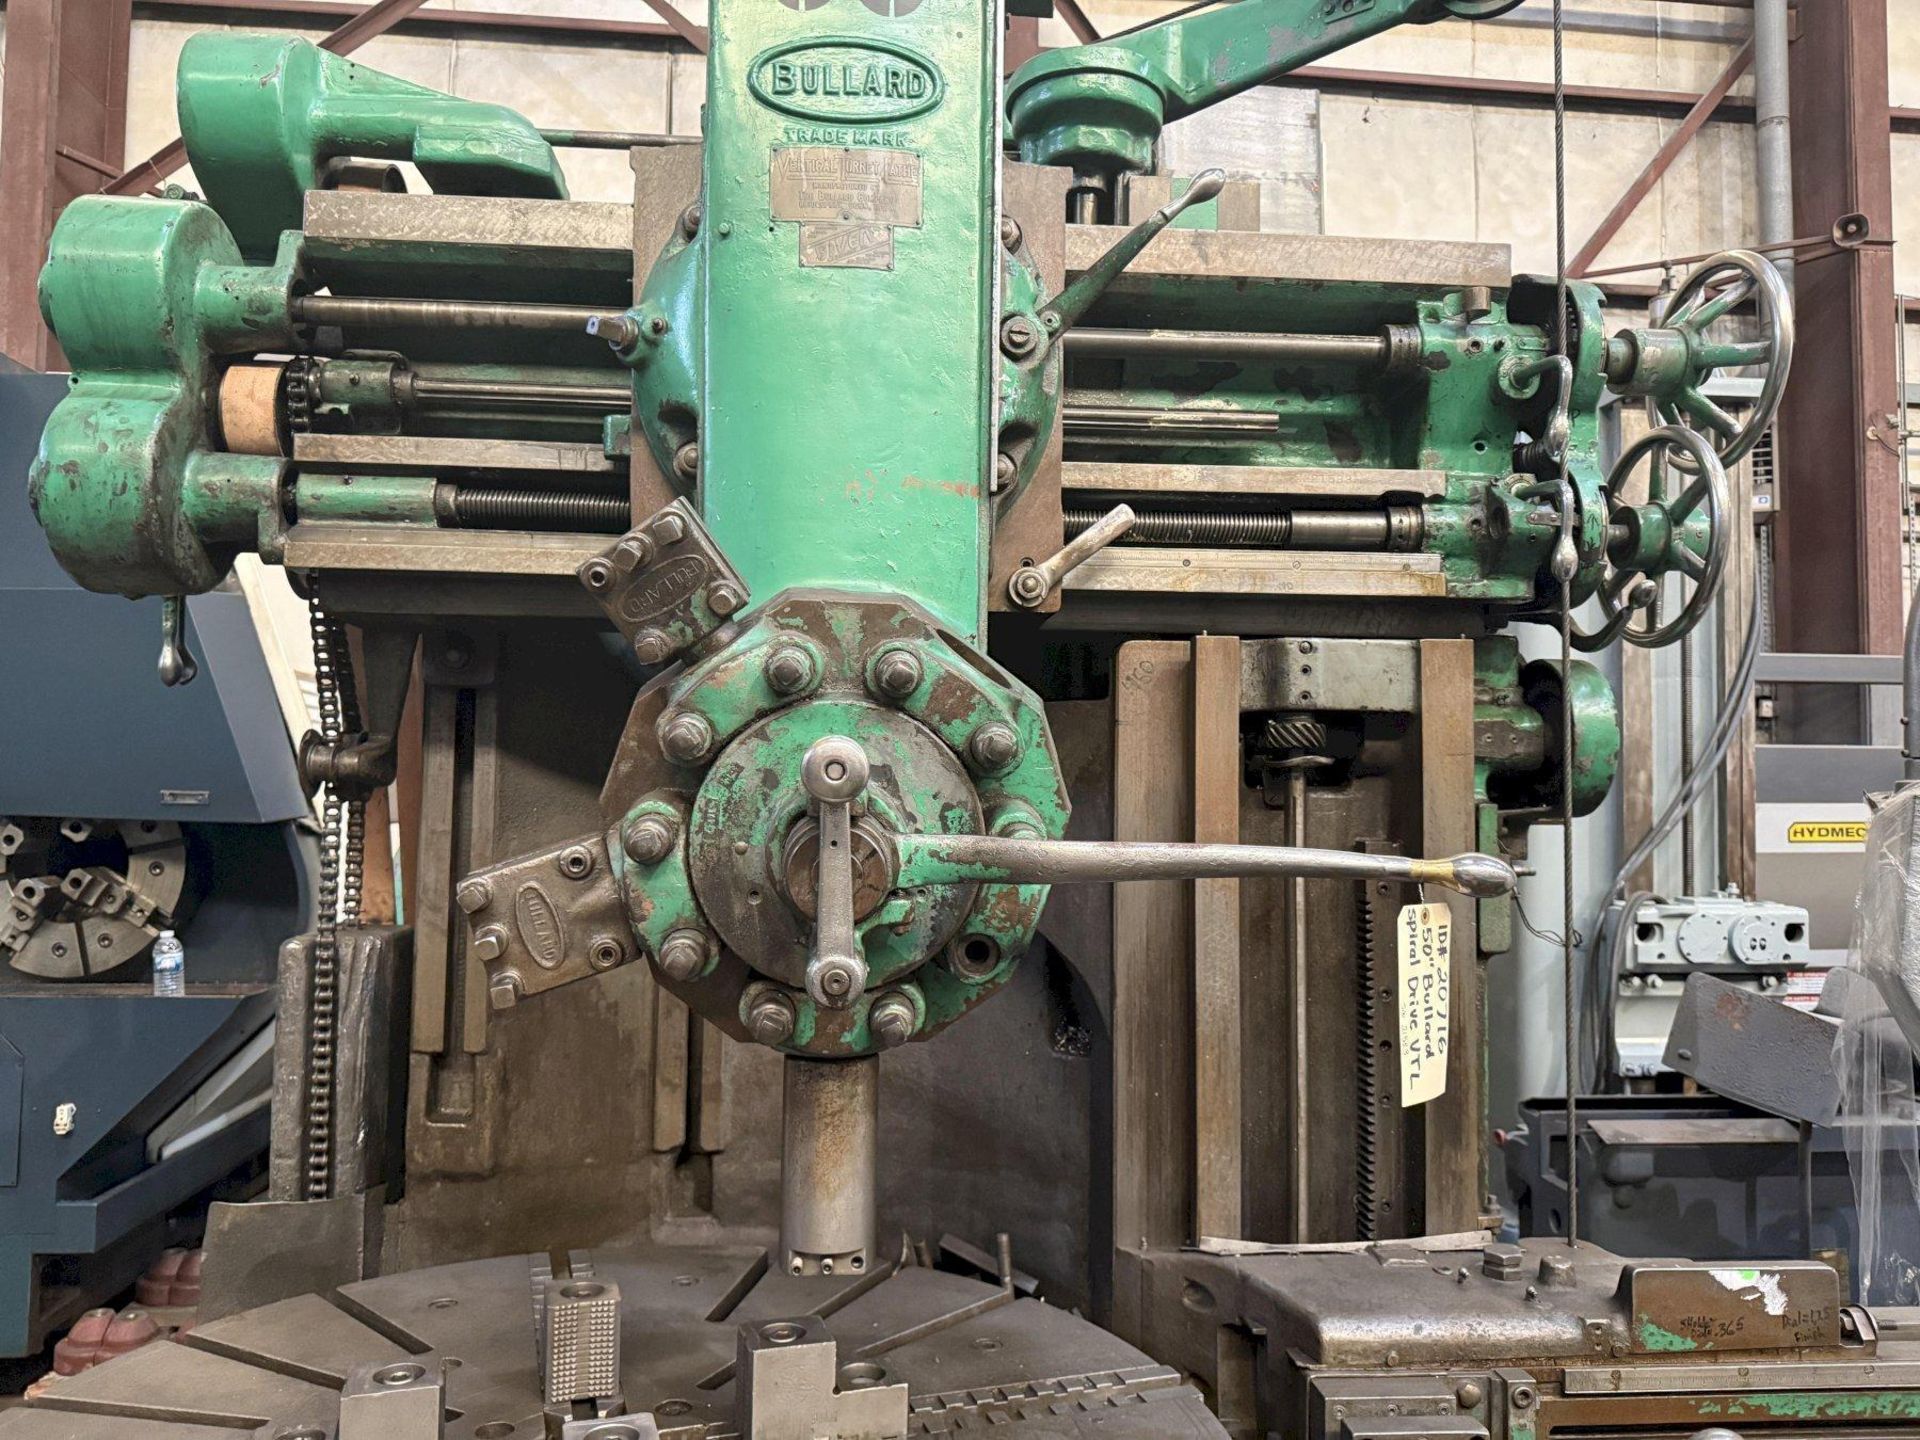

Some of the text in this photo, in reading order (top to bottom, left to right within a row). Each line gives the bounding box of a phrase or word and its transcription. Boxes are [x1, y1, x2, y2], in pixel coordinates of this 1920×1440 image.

[771, 62, 927, 99] BULLARD
[784, 127, 908, 147] TRADE MARK
[777, 152, 919, 183] VERTICAL TURRET LATHE
[1407, 976, 1420, 1030] Drive
[1422, 927, 1435, 1059] 50" Bullard
[1437, 924, 1448, 1055] ID# 20716
[1409, 1039, 1421, 1090] VTL
